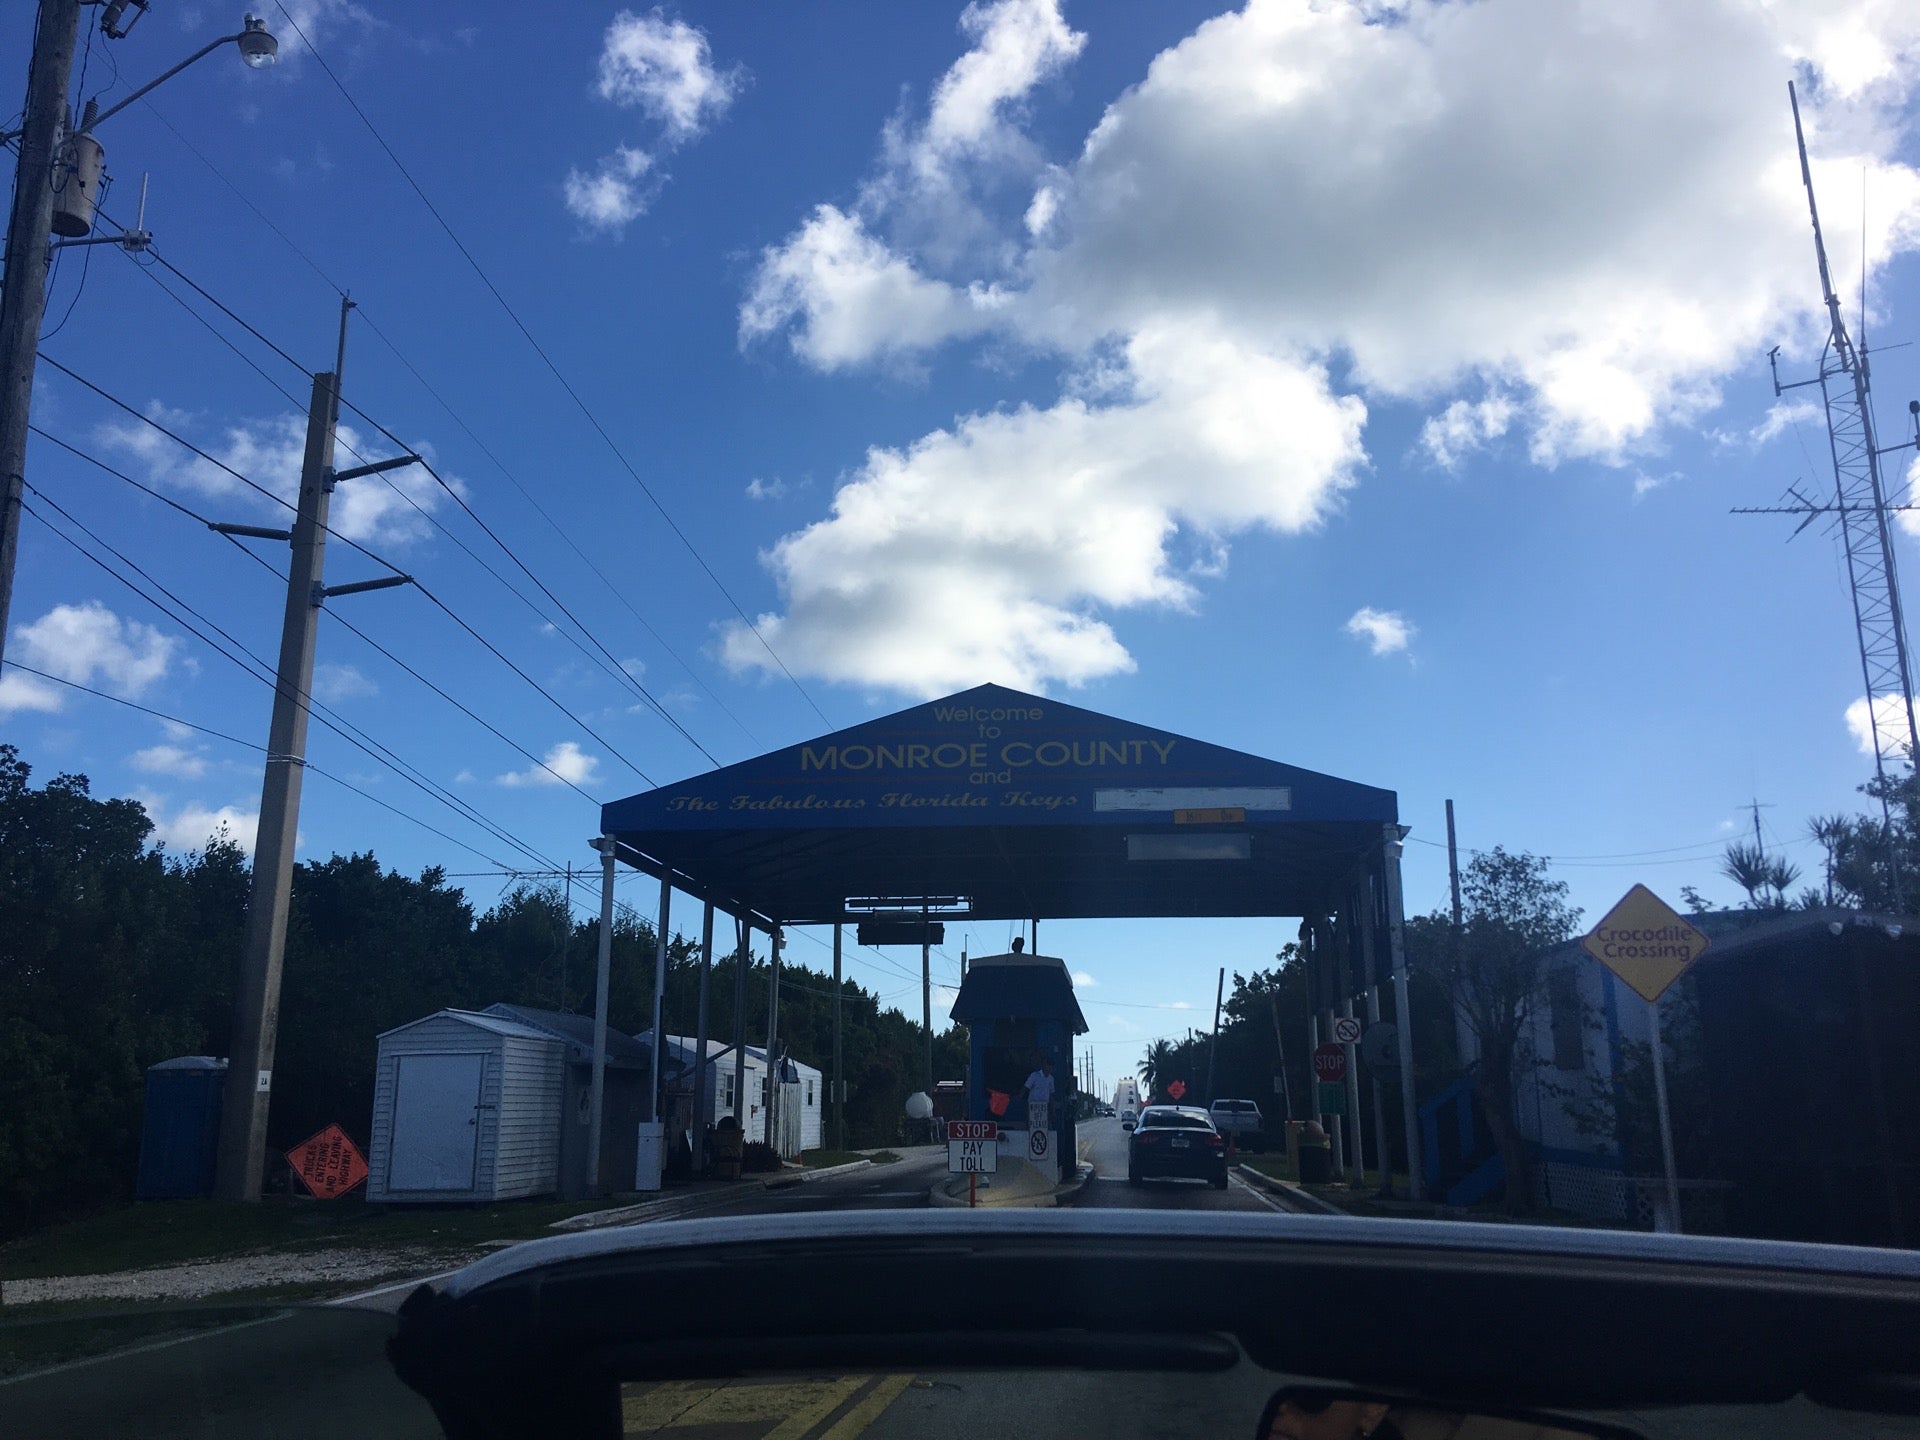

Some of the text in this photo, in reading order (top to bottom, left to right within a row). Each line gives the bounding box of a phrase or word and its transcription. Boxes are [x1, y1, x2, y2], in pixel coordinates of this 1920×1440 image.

[934, 706, 1044, 722] Welcome
[978, 723, 1001, 739] to
[800, 740, 1177, 771] MONROE COUNTY
[969, 768, 1012, 785] and
[665, 791, 1079, 812] The Fabulous Florida Keys
[1596, 926, 1693, 942] Crocodile
[1603, 943, 1690, 962] Crossing
[1315, 1054, 1345, 1070] STOP
[956, 1123, 990, 1138] STOP
[963, 1141, 984, 1155] PAY
[303, 1144, 318, 1177] TRUCKS
[314, 1142, 330, 1184] ENTERING
[325, 1135, 343, 1194] AND LEAVING
[338, 1148, 353, 1186] HIGHWAY
[960, 1156, 985, 1171] TOLL
